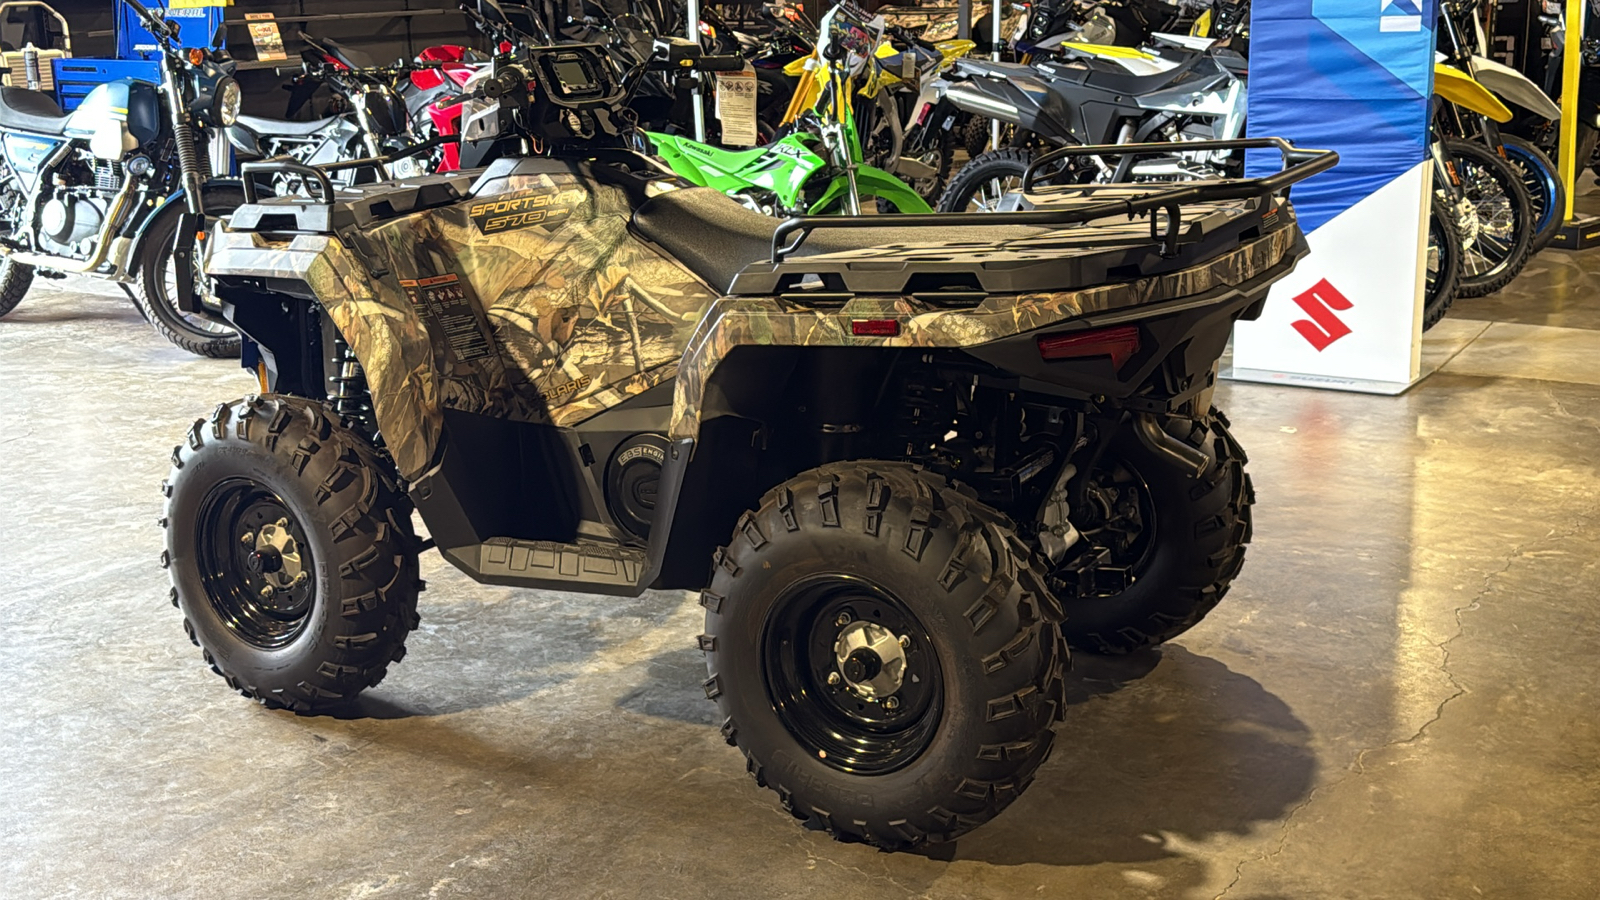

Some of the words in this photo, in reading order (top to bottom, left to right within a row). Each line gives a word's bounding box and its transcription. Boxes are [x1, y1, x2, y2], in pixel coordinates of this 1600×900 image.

[683, 142, 715, 157] Kawasaki
[776, 145, 809, 159] KLX
[470, 188, 588, 217] SPORTSMAN
[484, 210, 547, 232] 570
